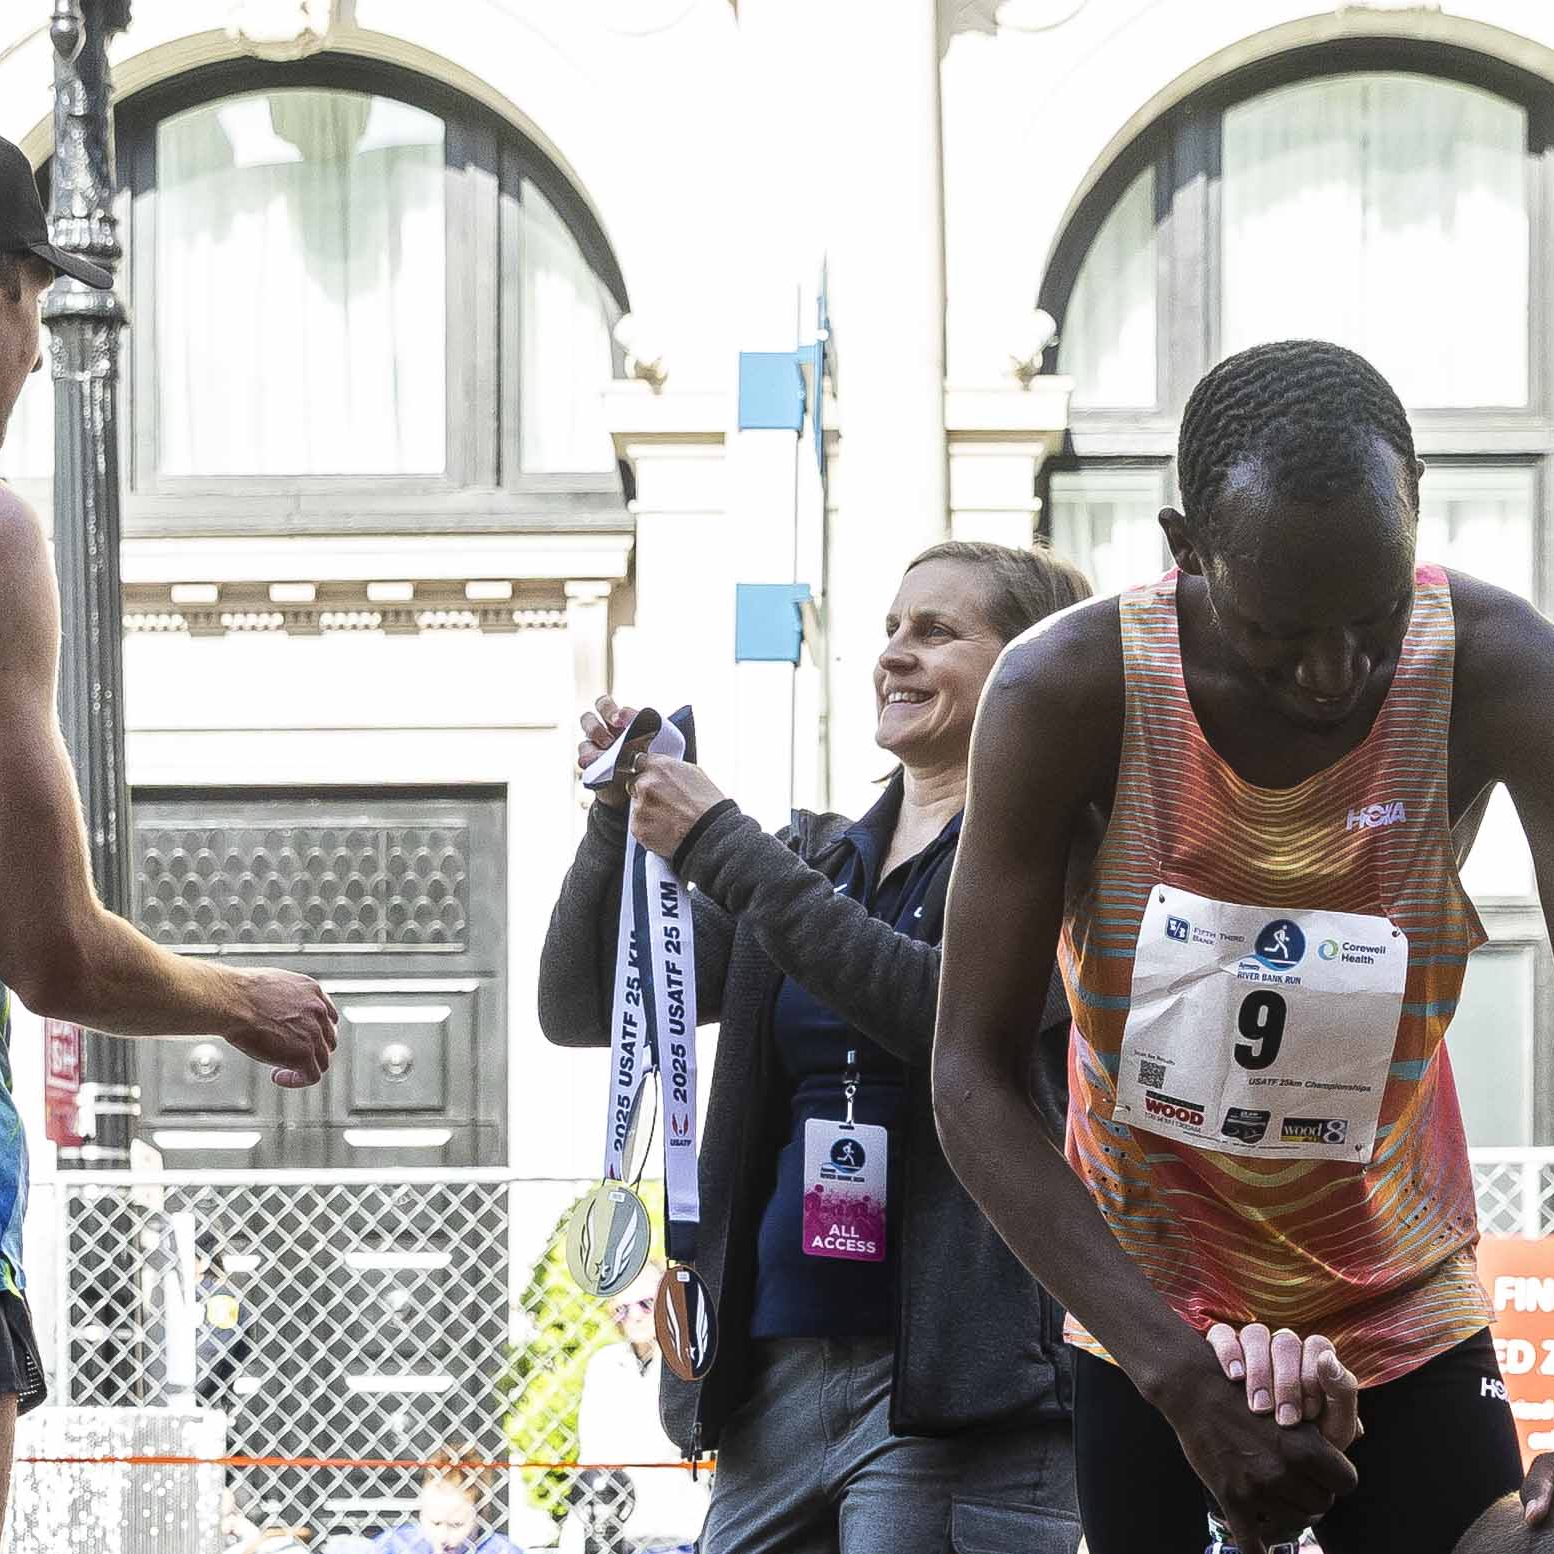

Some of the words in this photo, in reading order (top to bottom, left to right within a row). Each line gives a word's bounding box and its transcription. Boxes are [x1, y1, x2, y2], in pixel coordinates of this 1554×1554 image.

[1347, 802, 1407, 832] HOKA
[660, 881, 680, 919] KM
[663, 926, 682, 956] 25
[1341, 941, 1387, 955] Corewell
[1341, 954, 1375, 965] Health
[626, 975, 641, 1007] 25
[1237, 971, 1260, 983] RIVER
[1262, 973, 1284, 984] BANK
[1285, 974, 1302, 986] RUN
[665, 960, 686, 1036] USATF
[1233, 989, 1288, 1071] 9
[618, 1011, 638, 1088] USATF
[670, 1043, 688, 1104] 2025
[1249, 1077, 1278, 1087] USATF
[1279, 1078, 1303, 1088] 25km
[1304, 1080, 1372, 1092] Championships
[1145, 1097, 1204, 1126] WOOD
[1284, 1122, 1323, 1138] wood
[1323, 1119, 1346, 1144] 8
[811, 1235, 876, 1253] ACCESS
[829, 1223, 859, 1238] ALL
